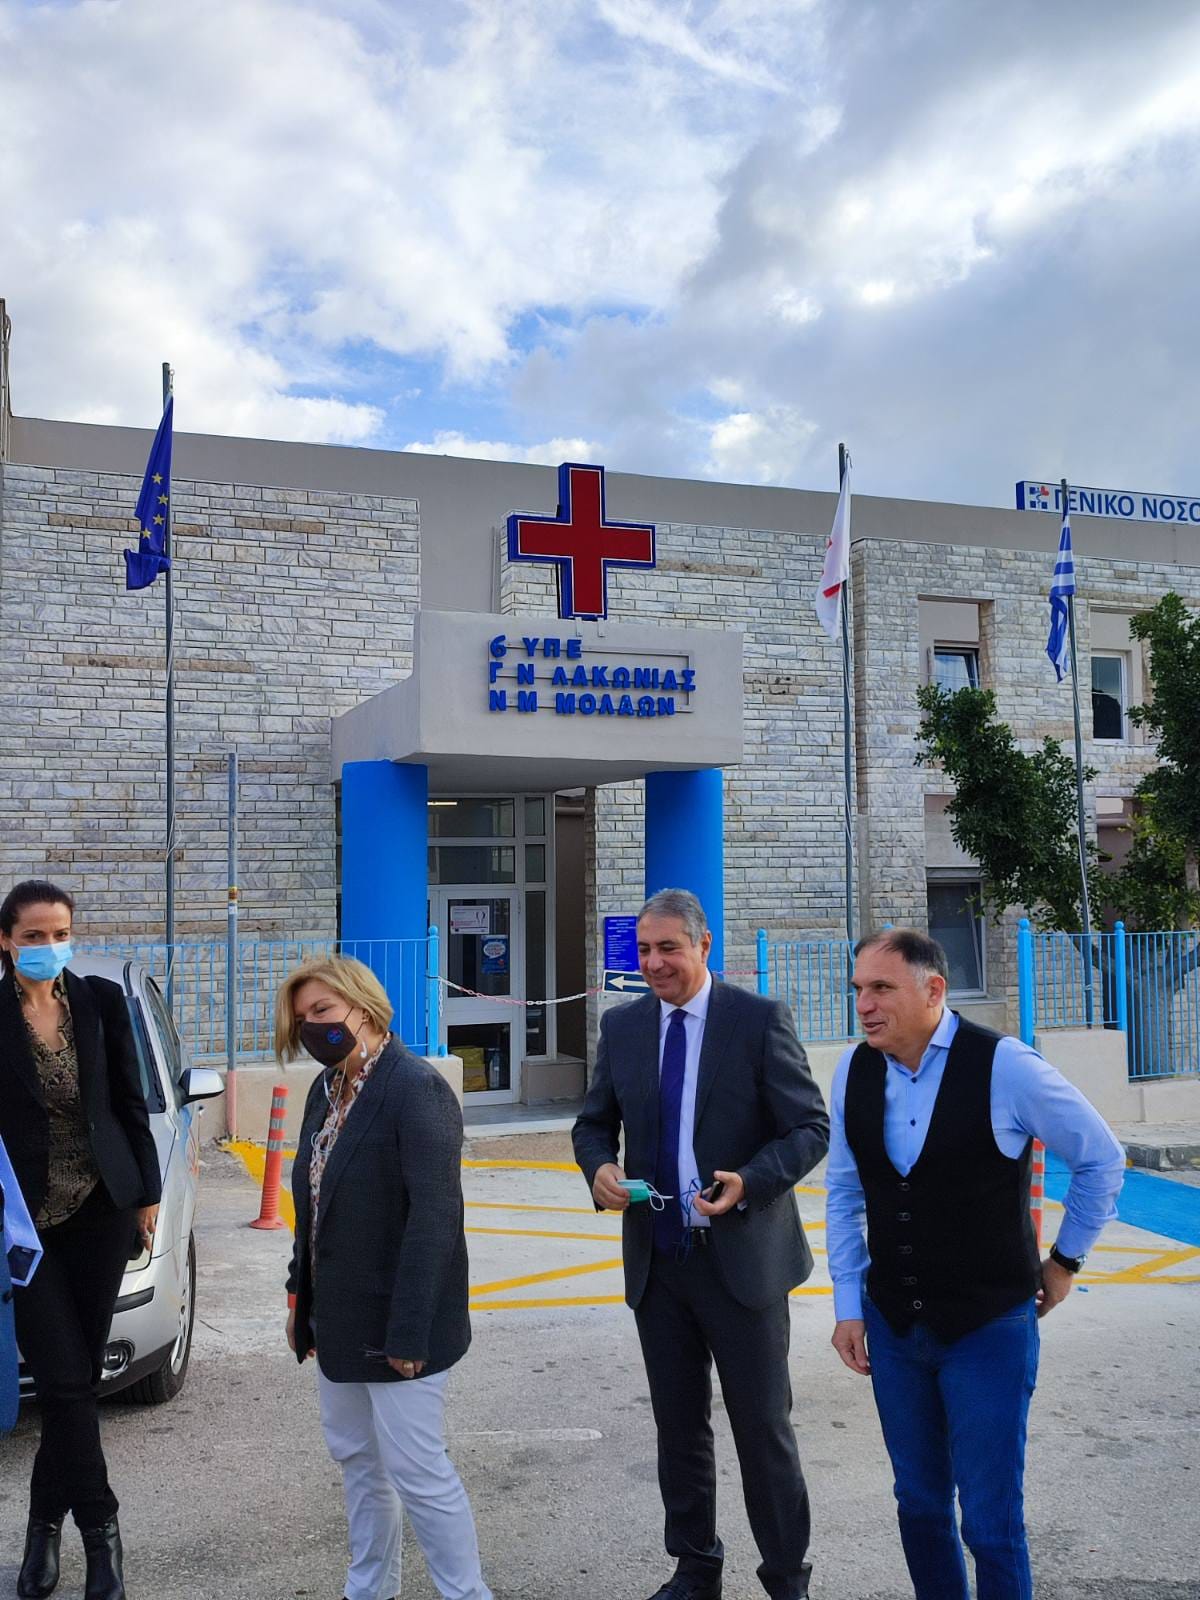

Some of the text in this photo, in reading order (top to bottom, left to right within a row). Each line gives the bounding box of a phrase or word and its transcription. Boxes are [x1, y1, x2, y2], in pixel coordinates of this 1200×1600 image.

[1053, 488, 1135, 517] ΓΕΝΙΚΟ
[489, 634, 582, 659] 6 ΥΠΕ
[489, 661, 696, 691] Γ Ν ΛΑΚΩΝΙΑΣ
[489, 689, 675, 717] Ν Μ ΜΟΛΑΩΝ
